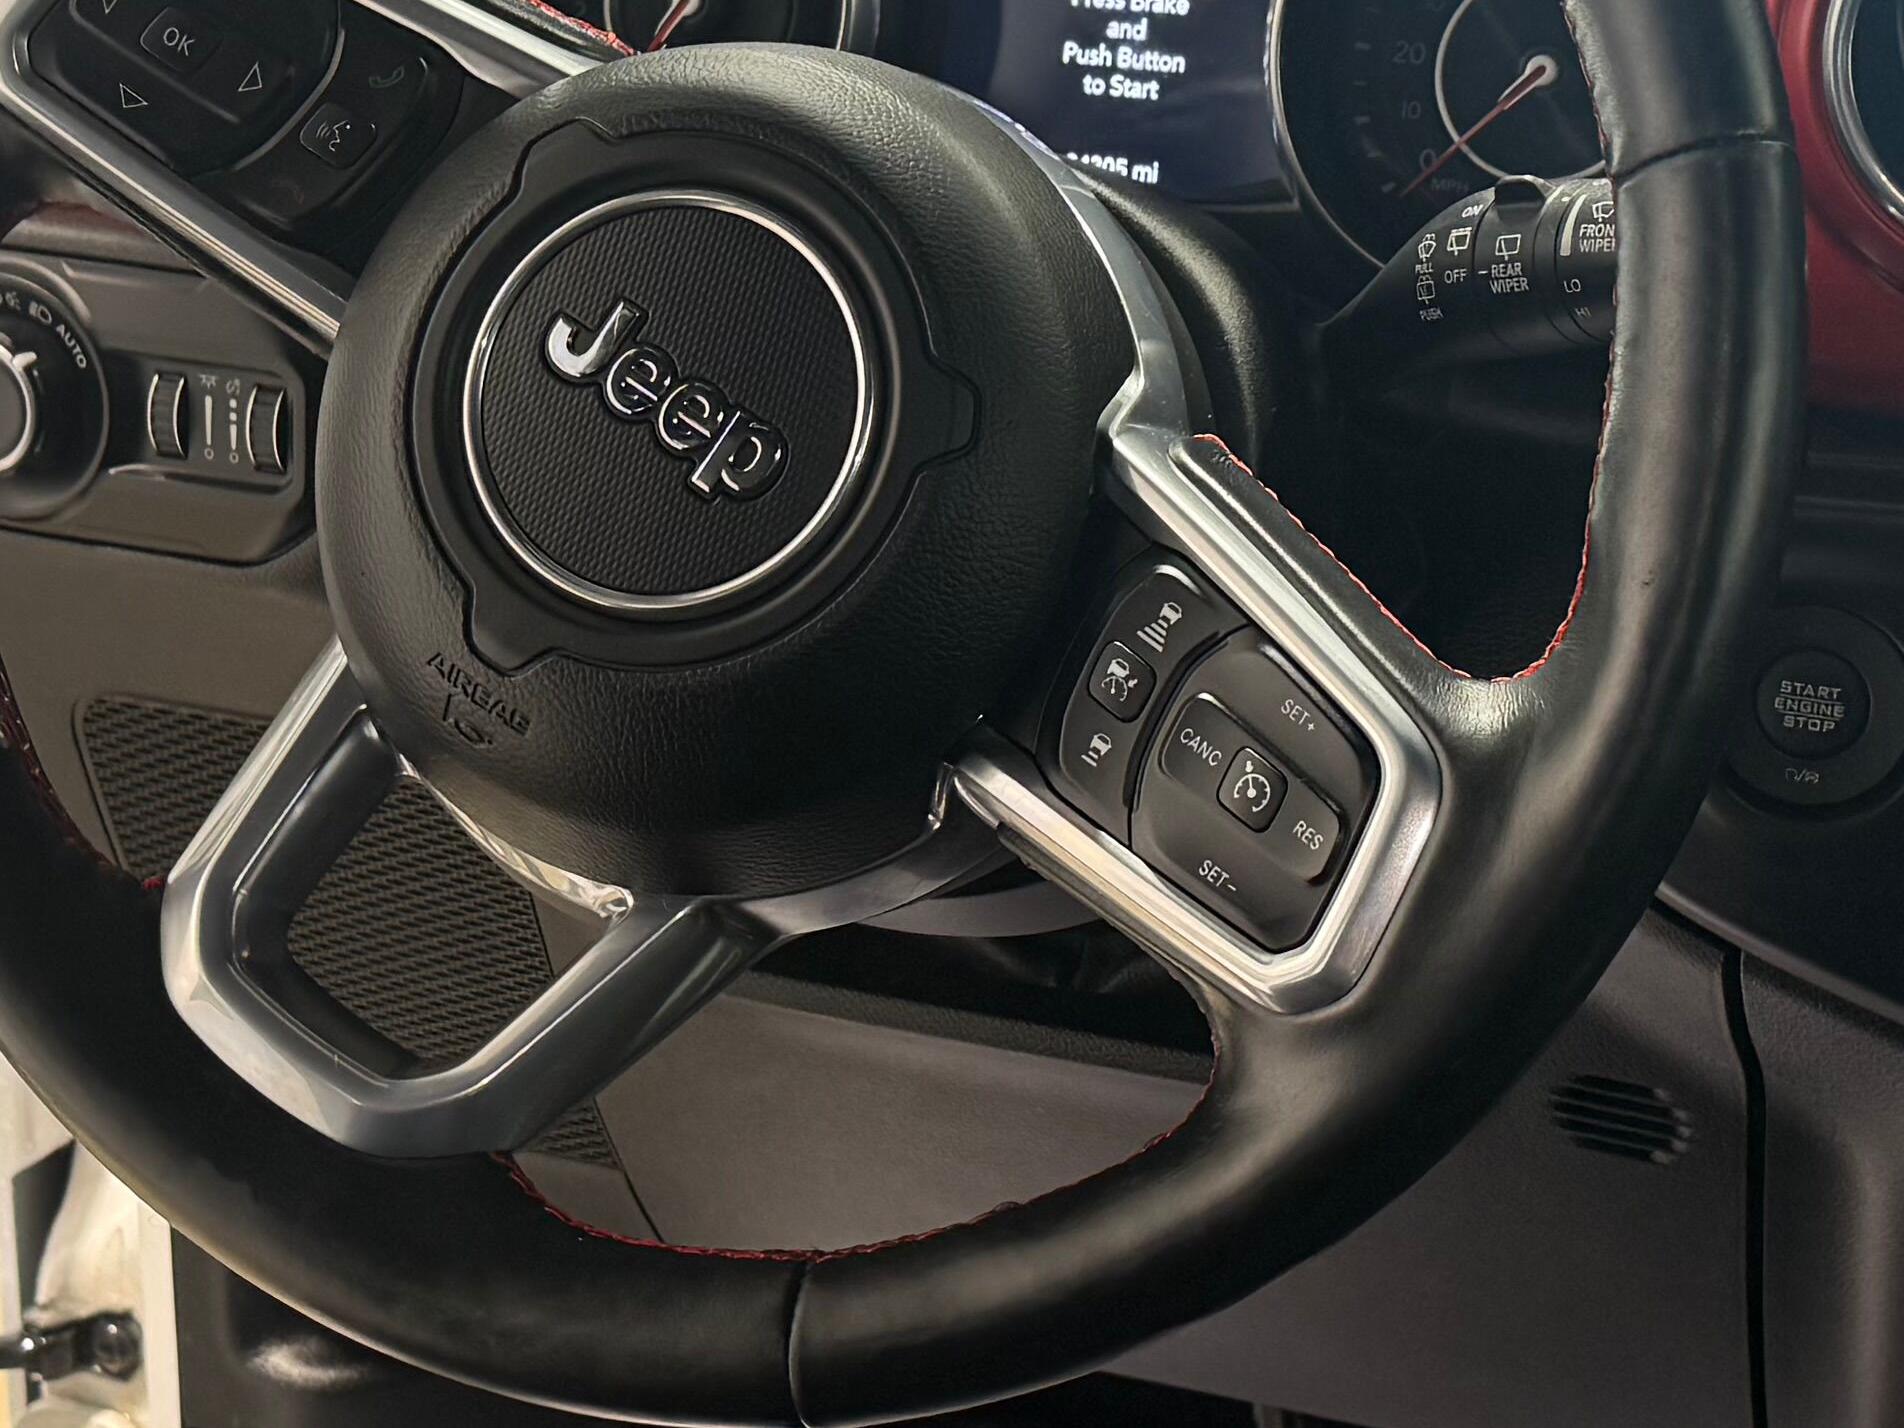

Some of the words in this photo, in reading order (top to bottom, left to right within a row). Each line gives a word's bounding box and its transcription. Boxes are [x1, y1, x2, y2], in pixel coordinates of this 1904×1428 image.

[162, 25, 196, 56] OK
[1106, 18, 1148, 42] and
[1062, 41, 1112, 68] Push
[1116, 46, 1186, 74] Button
[1392, 41, 1426, 64] 20
[1082, 74, 1106, 96] to
[1108, 74, 1161, 101] Start
[1131, 160, 1160, 185] mi
[1578, 224, 1616, 238] FRON
[1444, 268, 1468, 285] OFF
[1490, 261, 1523, 278] REAR
[1489, 276, 1530, 296] WIPER
[1563, 278, 1582, 293] LO
[55, 323, 88, 371] AUTO
[546, 298, 789, 497] Jeep
[1780, 679, 1843, 701] START
[1773, 696, 1846, 719] ENGINE
[1782, 714, 1837, 733] STOP
[1179, 727, 1223, 768] CANC
[1292, 819, 1324, 851] RES
